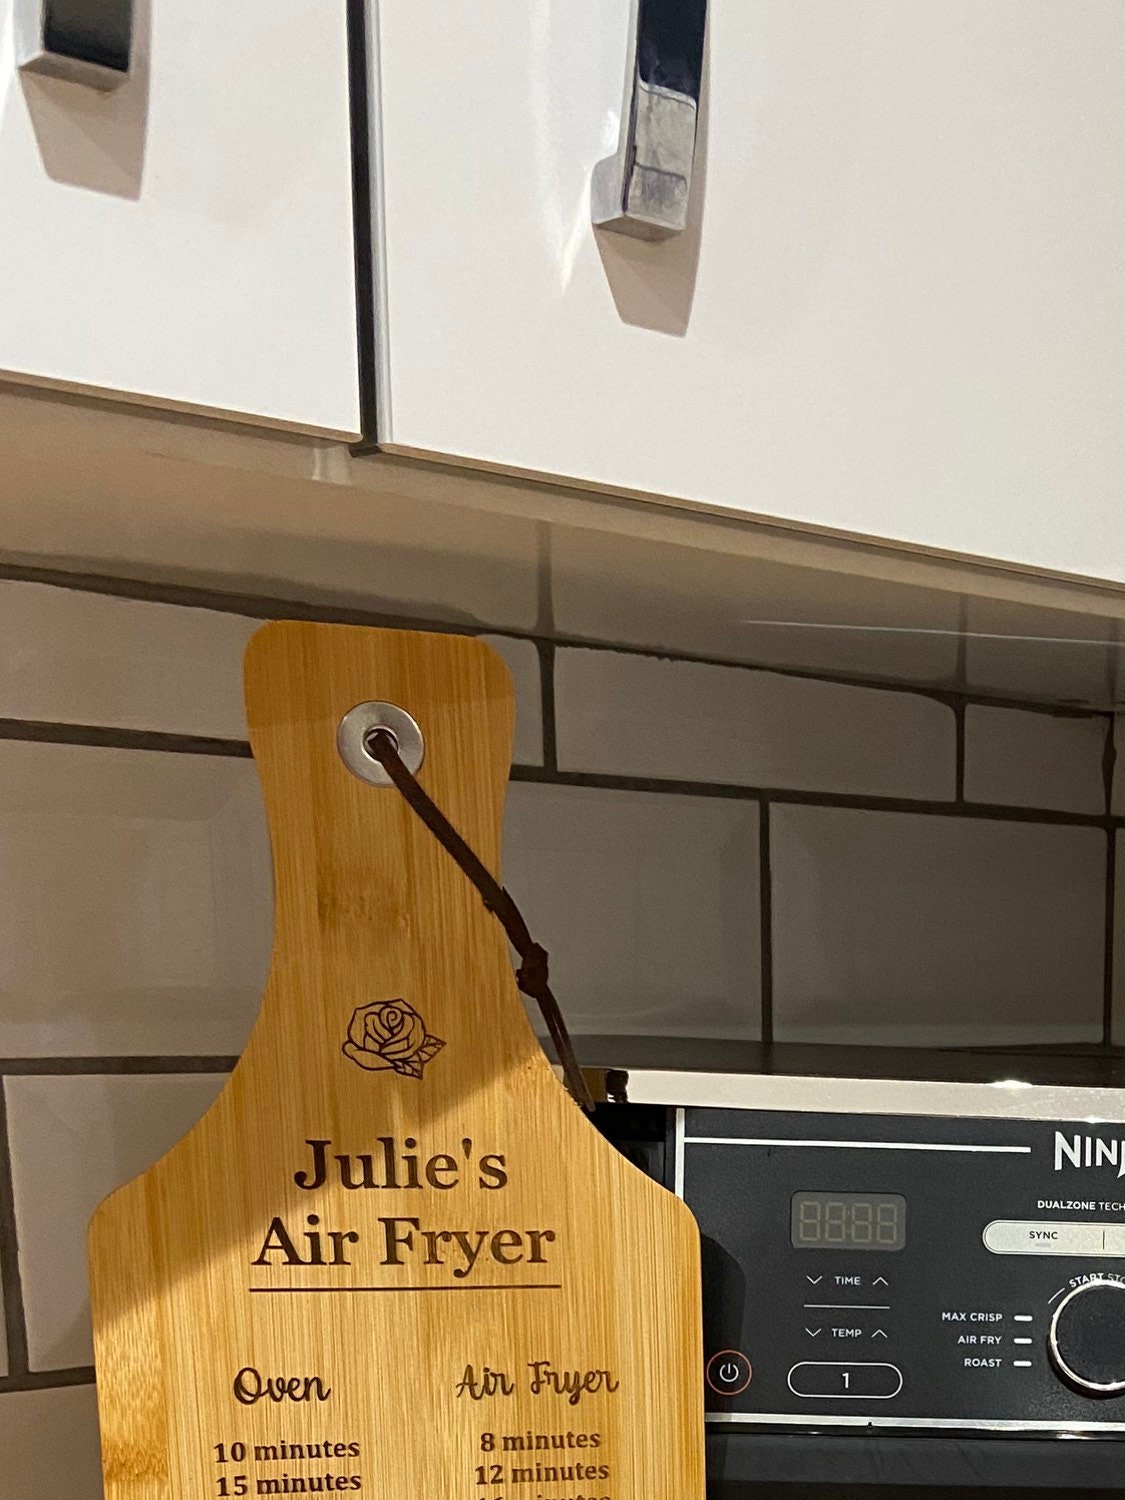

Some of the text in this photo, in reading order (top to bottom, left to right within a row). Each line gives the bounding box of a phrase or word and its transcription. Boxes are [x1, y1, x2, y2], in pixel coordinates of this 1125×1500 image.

[294, 1137, 508, 1190] Julie's
[1038, 1200, 1096, 1210] DUALZONE
[1029, 1231, 1058, 1240] SYNC
[251, 1214, 556, 1278] Air Fryer
[834, 1276, 861, 1286] TIME
[1069, 1273, 1104, 1288] START
[942, 1312, 1002, 1322] MAX CRISP
[831, 1328, 862, 1339] TEMP
[958, 1336, 1002, 1344] AIR FRY
[964, 1358, 1002, 1367] ROAST
[233, 1367, 331, 1404] Oven
[456, 1362, 619, 1405] Air Fryer
[842, 1373, 850, 1389] 1
[480, 1431, 601, 1452] 8 minutes
[213, 1440, 361, 1463] 10 minutes
[474, 1462, 610, 1485] 12 minutes
[216, 1472, 362, 1496] 15 minutes
